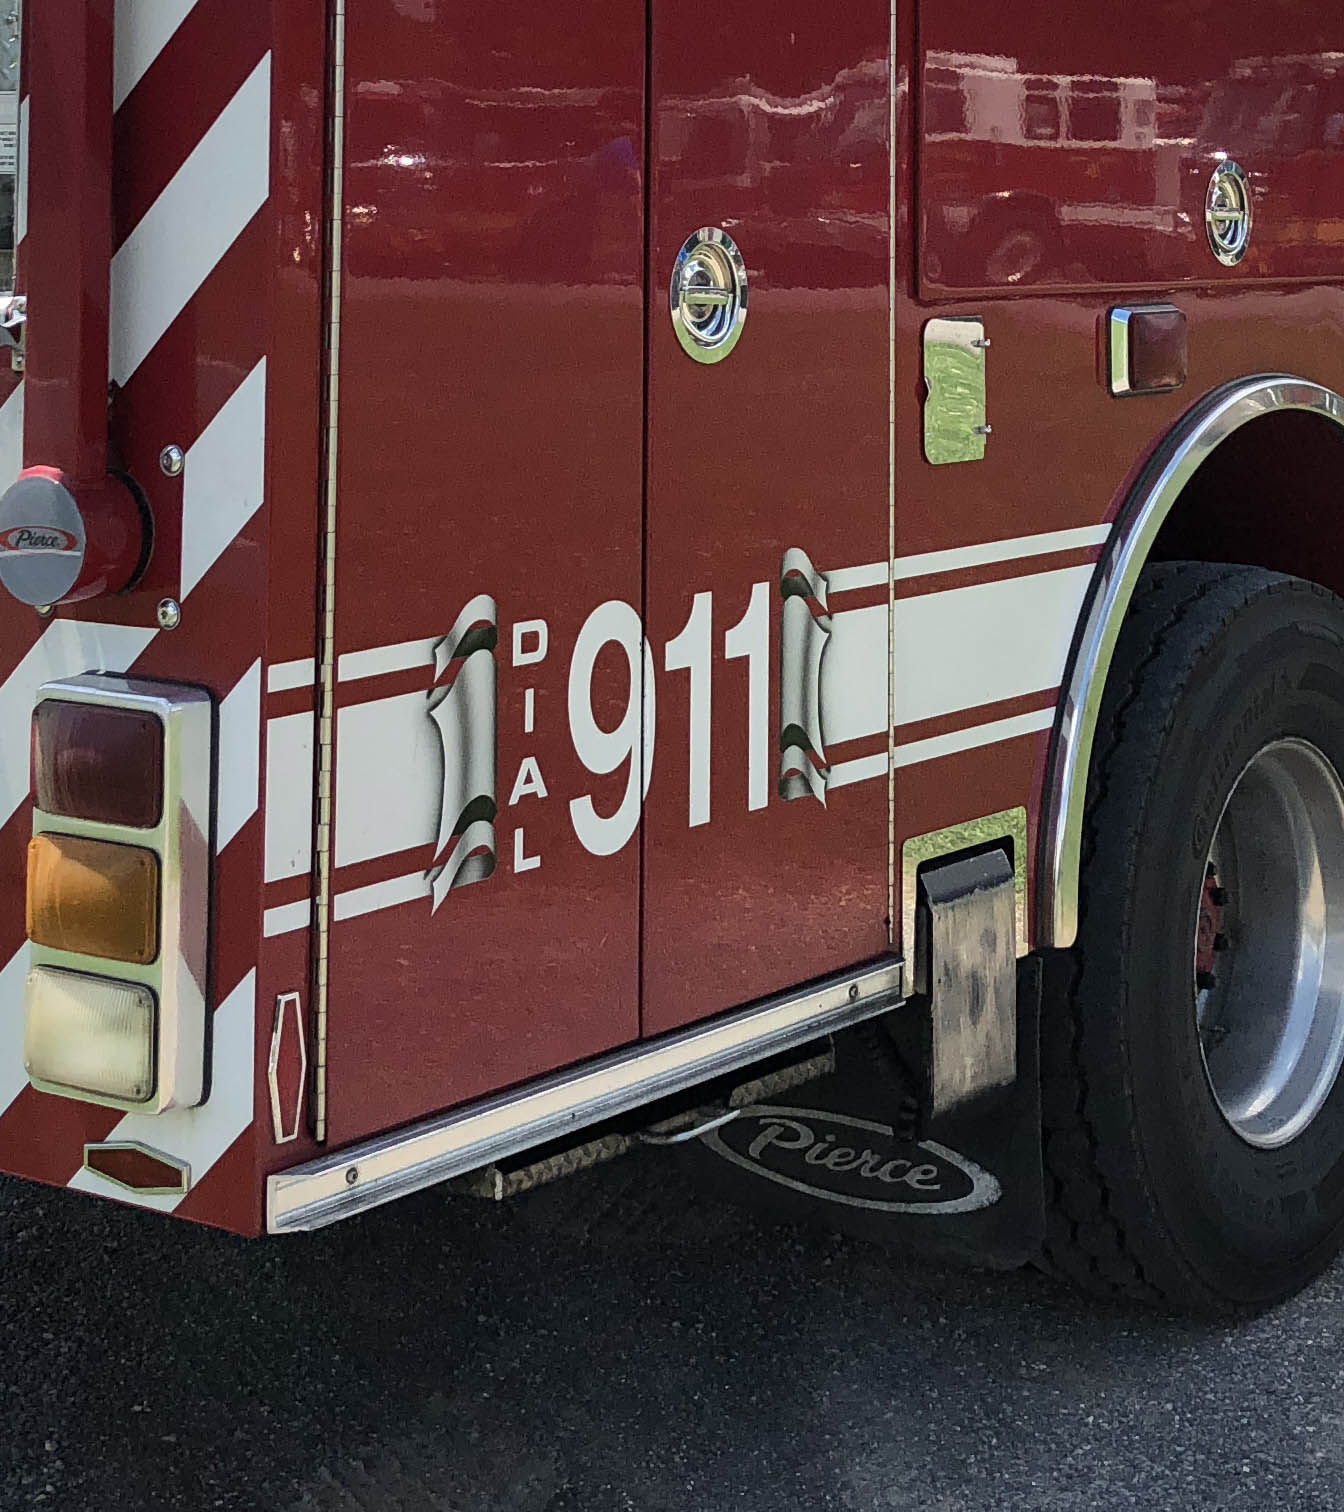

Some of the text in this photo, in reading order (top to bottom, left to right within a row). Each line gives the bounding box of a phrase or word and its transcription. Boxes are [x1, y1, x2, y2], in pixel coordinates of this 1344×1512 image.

[14, 528, 60, 548] Pierce
[508, 581, 770, 874] DIAL 911
[748, 1116, 941, 1191] Pierce
